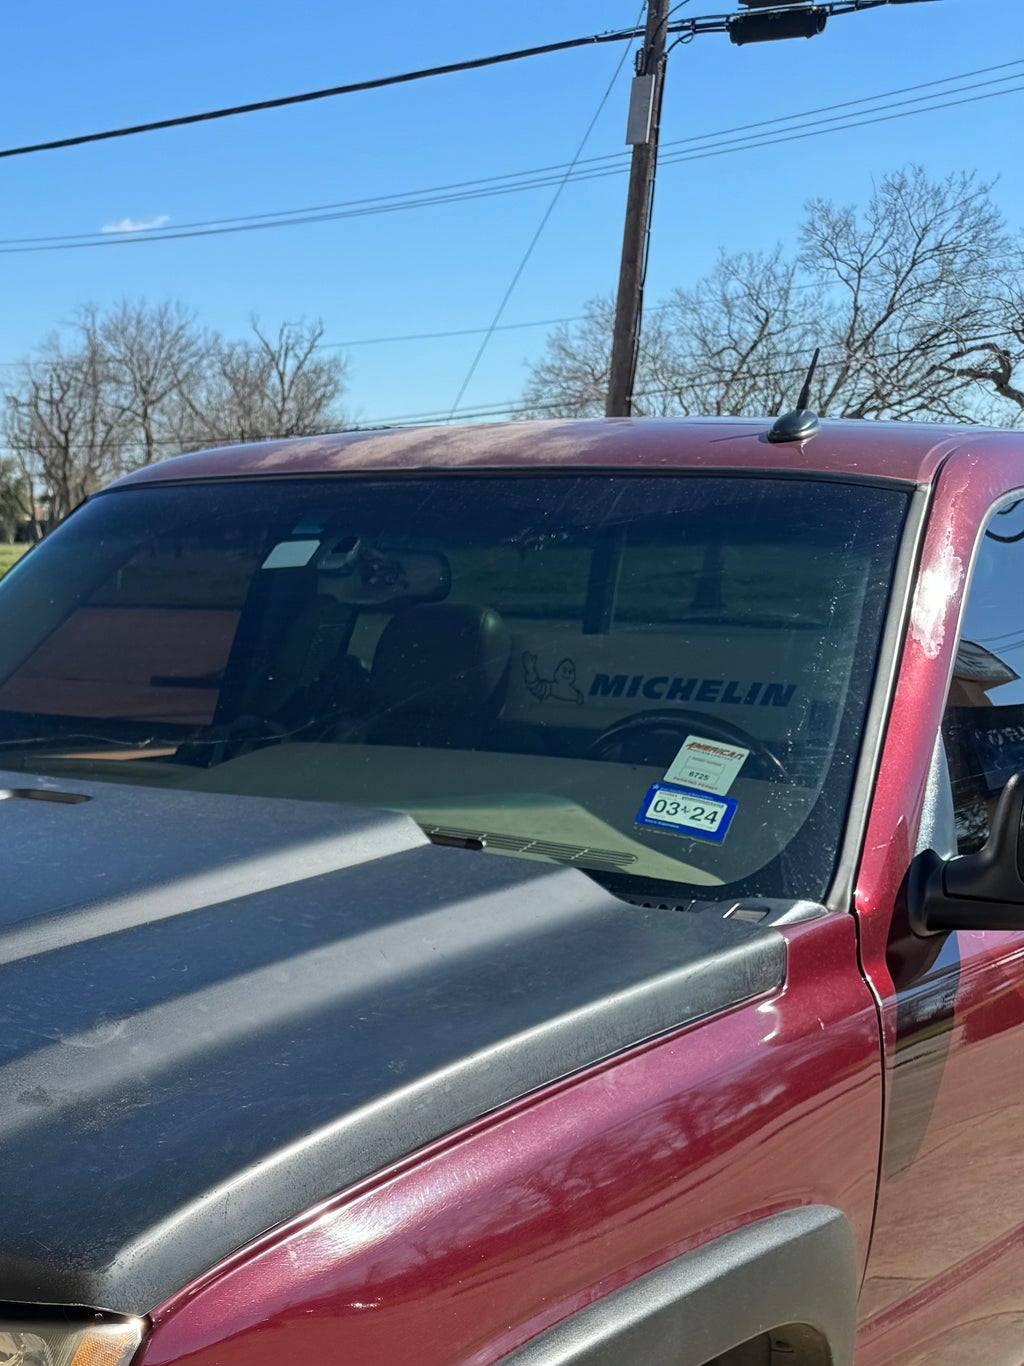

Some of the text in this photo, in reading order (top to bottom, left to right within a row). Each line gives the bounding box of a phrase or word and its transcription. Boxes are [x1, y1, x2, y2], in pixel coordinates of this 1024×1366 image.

[588, 673, 797, 707] MICHELIN
[686, 742, 745, 760] AMERICAN
[689, 771, 710, 781] 6725
[653, 799, 681, 816] 03
[689, 806, 719, 825] 24
